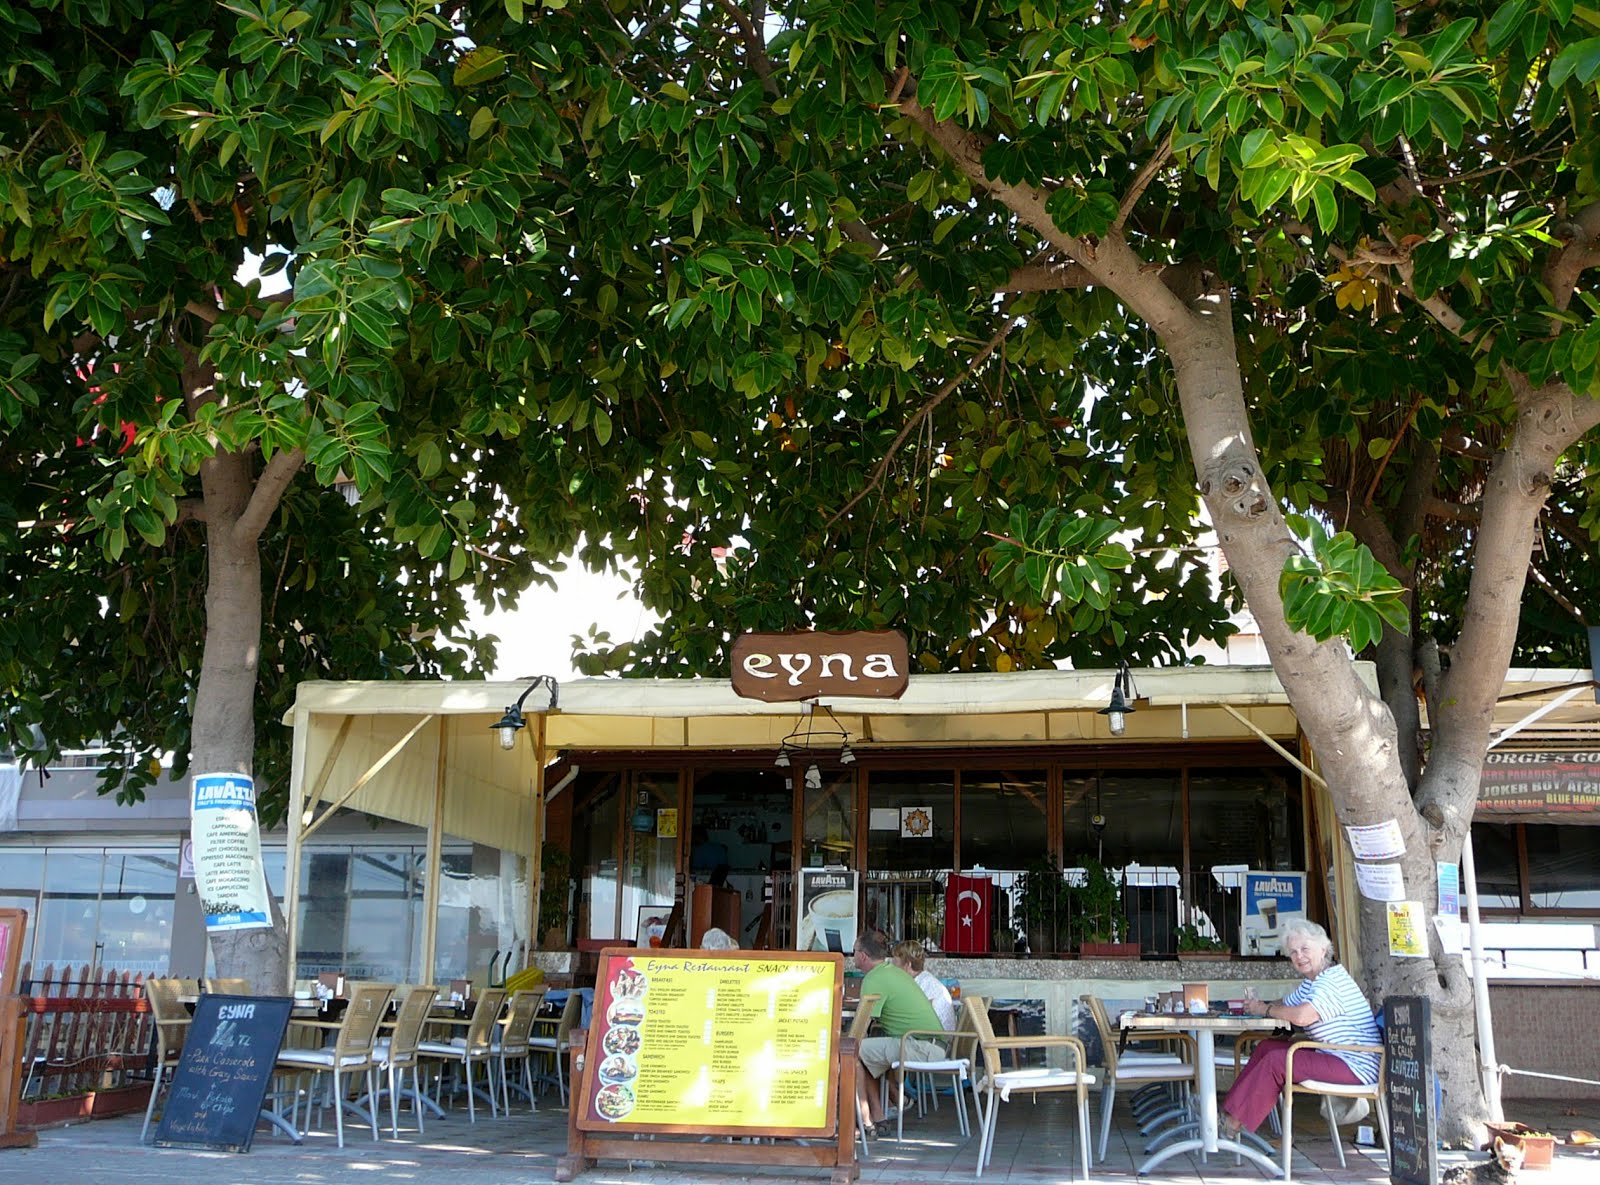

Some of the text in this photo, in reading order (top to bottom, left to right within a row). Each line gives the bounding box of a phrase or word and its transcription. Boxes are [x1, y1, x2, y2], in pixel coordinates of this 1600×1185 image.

[743, 653, 899, 686] eyna
[1484, 780, 1561, 798] JOKER BOY
[1546, 793, 1571, 804] BLUE
[811, 874, 846, 885] LAVAZZA
[1254, 878, 1294, 892] LAVAZZA
[647, 960, 680, 974] Eyna
[683, 961, 750, 973] Restaurant
[218, 1004, 256, 1019] EYNA
[1390, 1059, 1420, 1080] LAVAZZA
